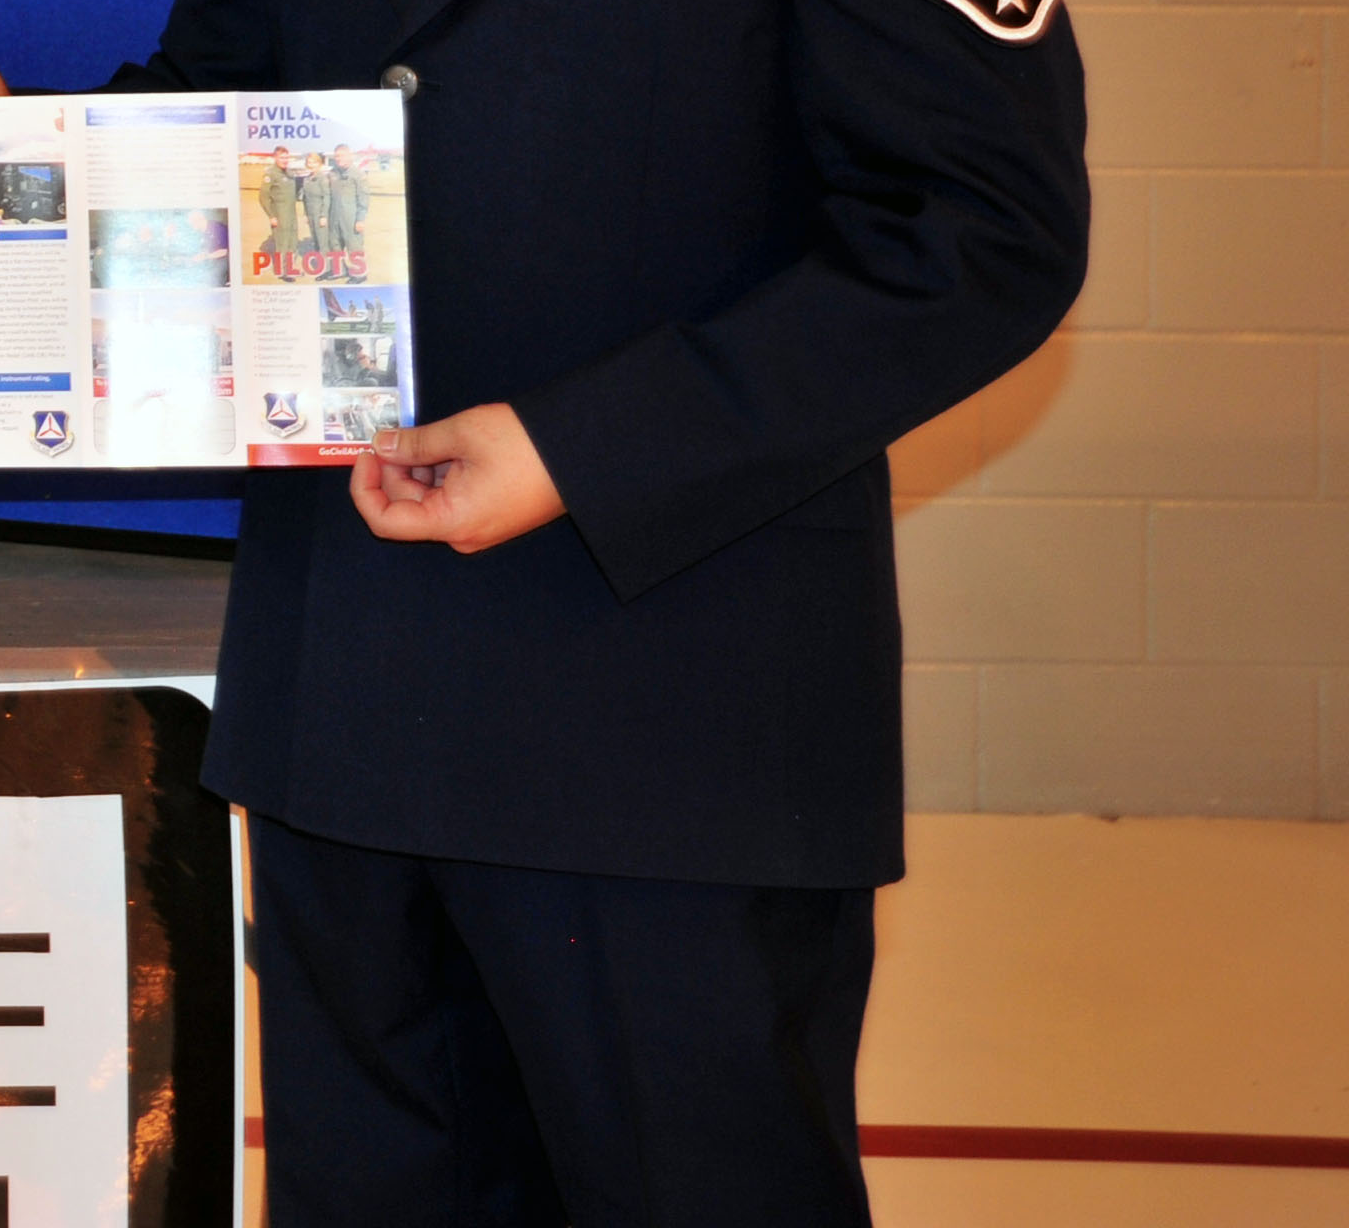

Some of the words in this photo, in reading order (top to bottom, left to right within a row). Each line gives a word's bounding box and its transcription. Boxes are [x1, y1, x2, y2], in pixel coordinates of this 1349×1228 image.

[247, 106, 296, 121] CIVIL
[247, 124, 321, 139] PATROL
[253, 251, 367, 276] PILOTS
